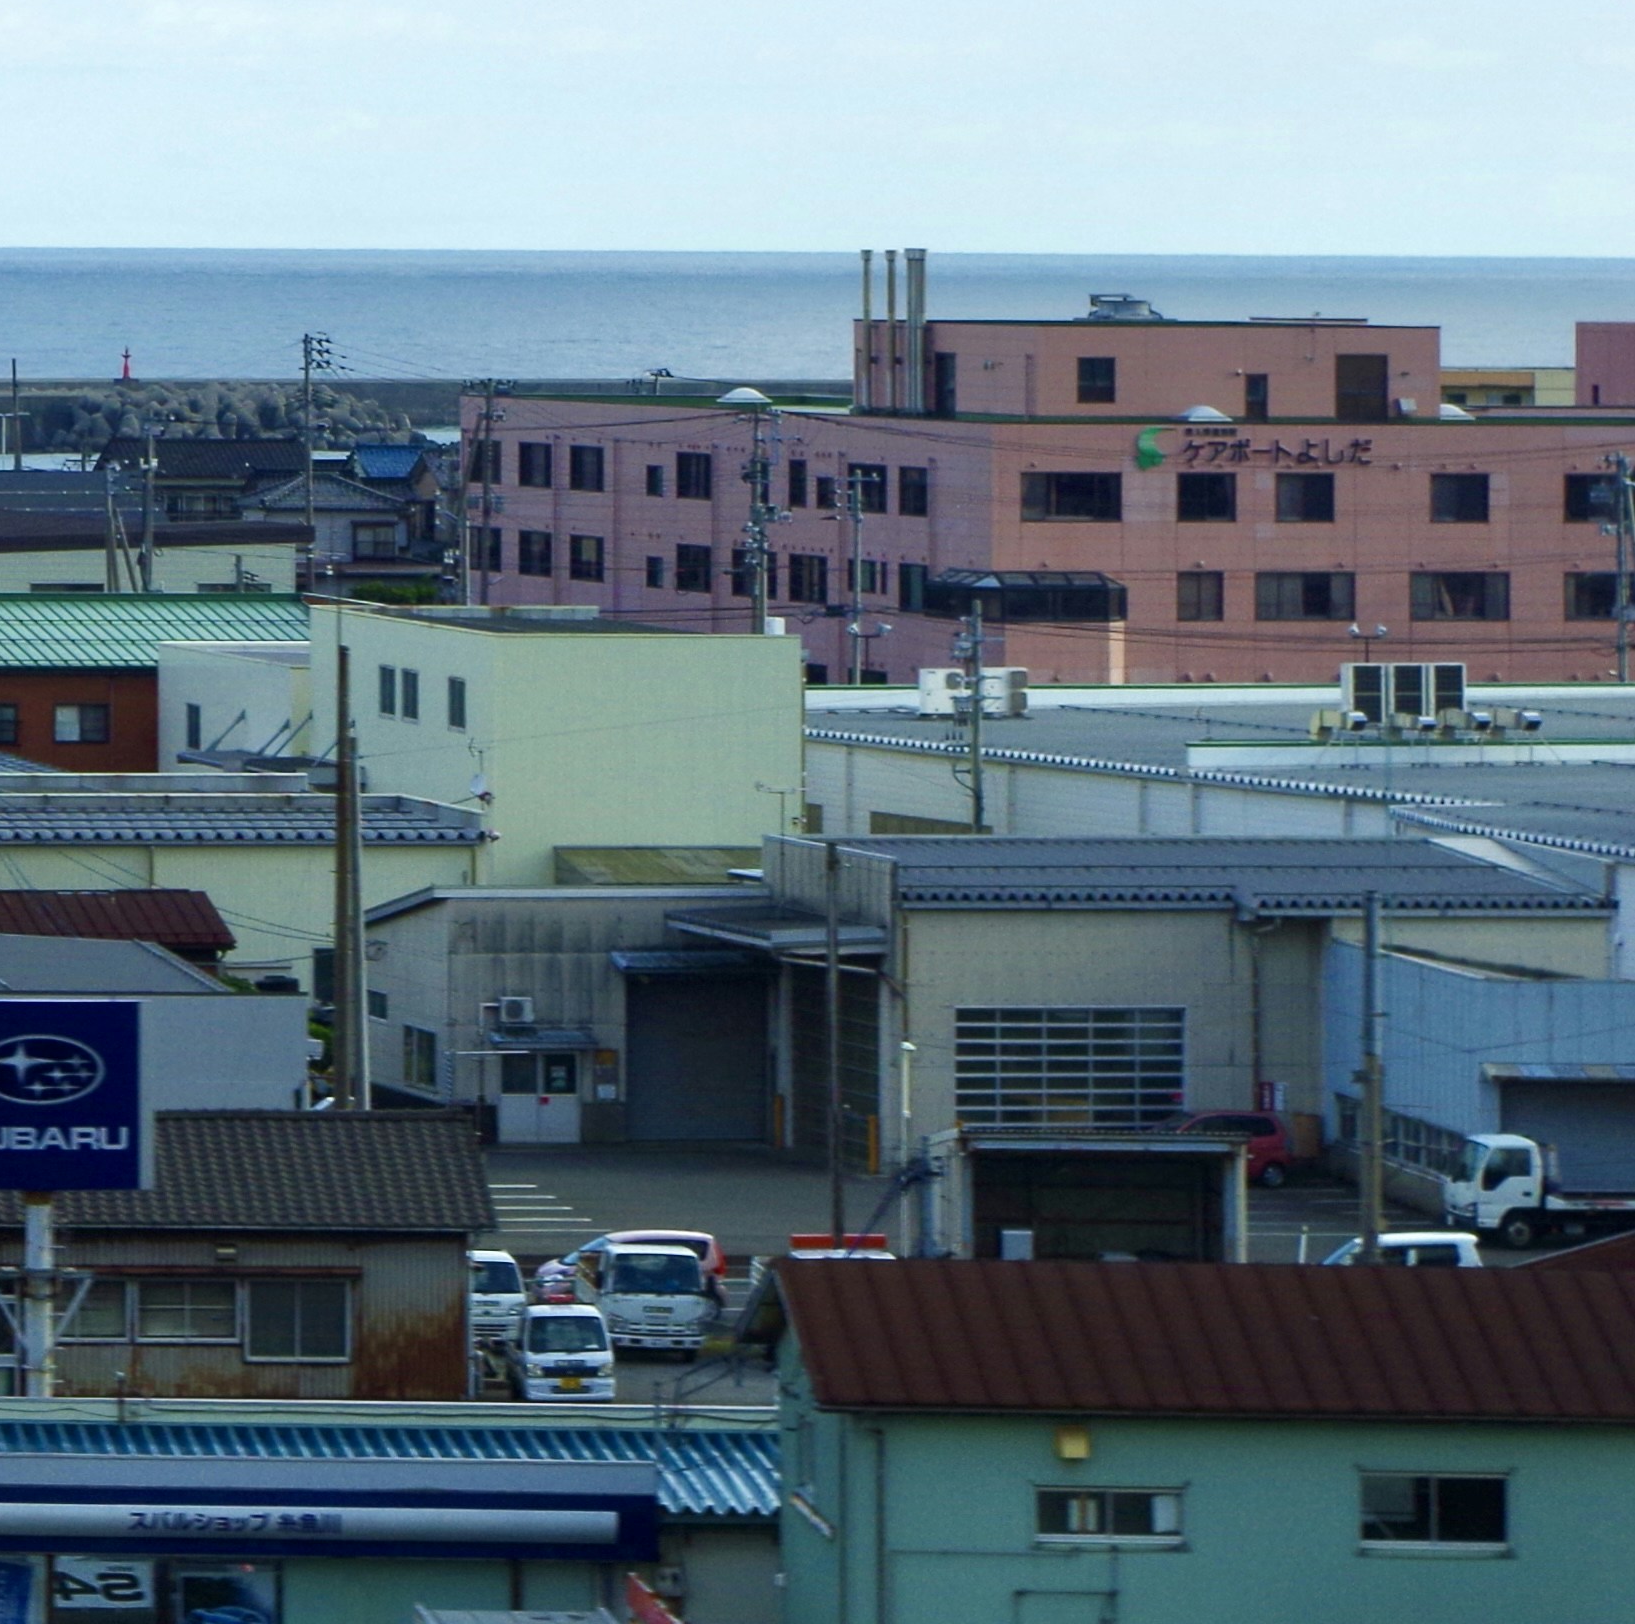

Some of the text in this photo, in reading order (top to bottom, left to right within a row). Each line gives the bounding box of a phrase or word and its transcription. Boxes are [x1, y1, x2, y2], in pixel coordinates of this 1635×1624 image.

[128, 1511, 271, 1532] スバルショップ
